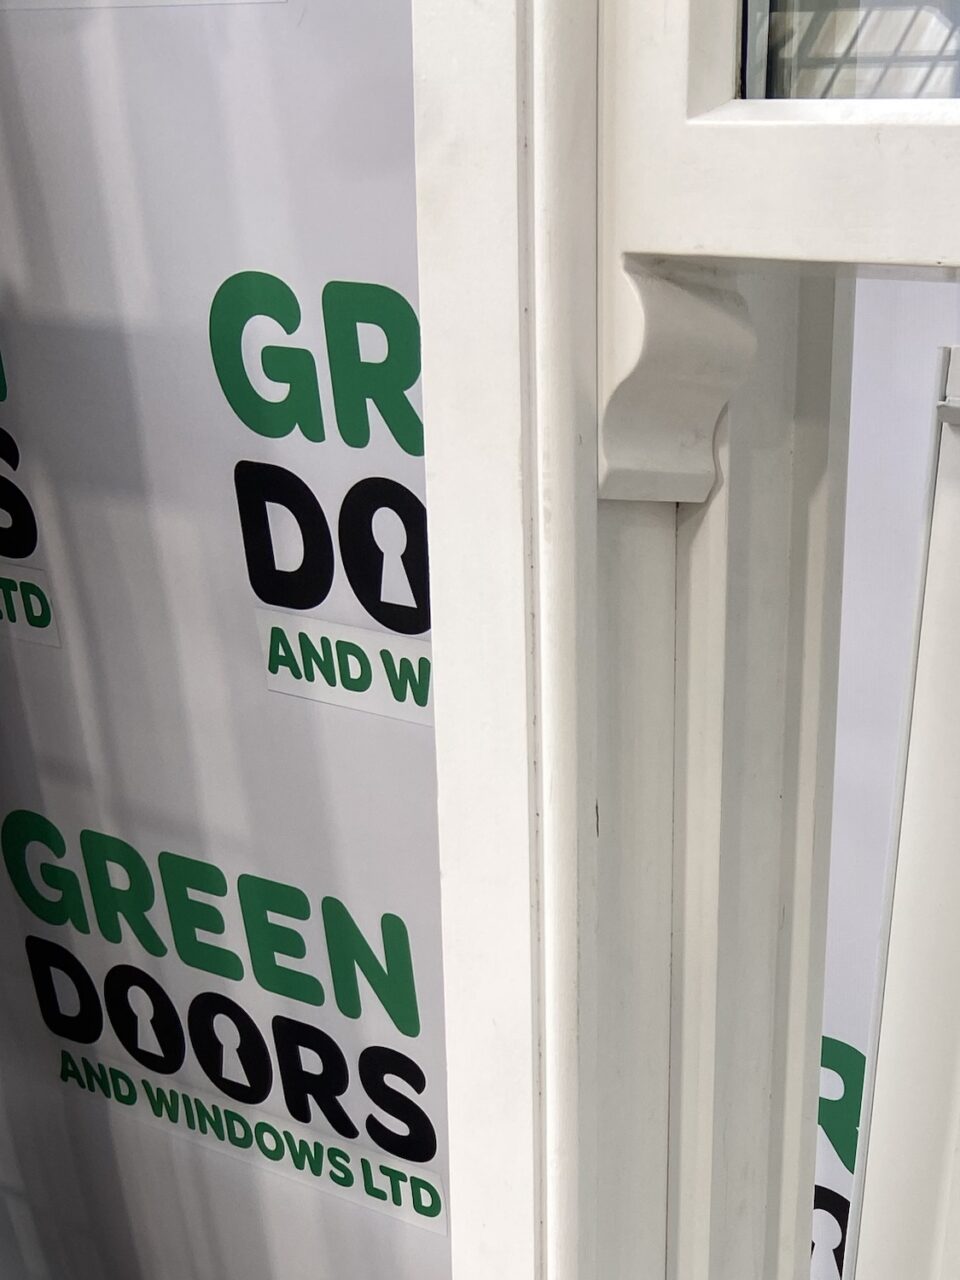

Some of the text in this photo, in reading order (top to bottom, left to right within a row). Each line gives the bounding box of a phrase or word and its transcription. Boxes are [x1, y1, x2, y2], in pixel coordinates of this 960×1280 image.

[267, 626, 373, 693] AND
[1, 810, 421, 1038] GREEN
[25, 935, 437, 1163] DOORS
[60, 1050, 442, 1217] AND WINDOWS LTD
